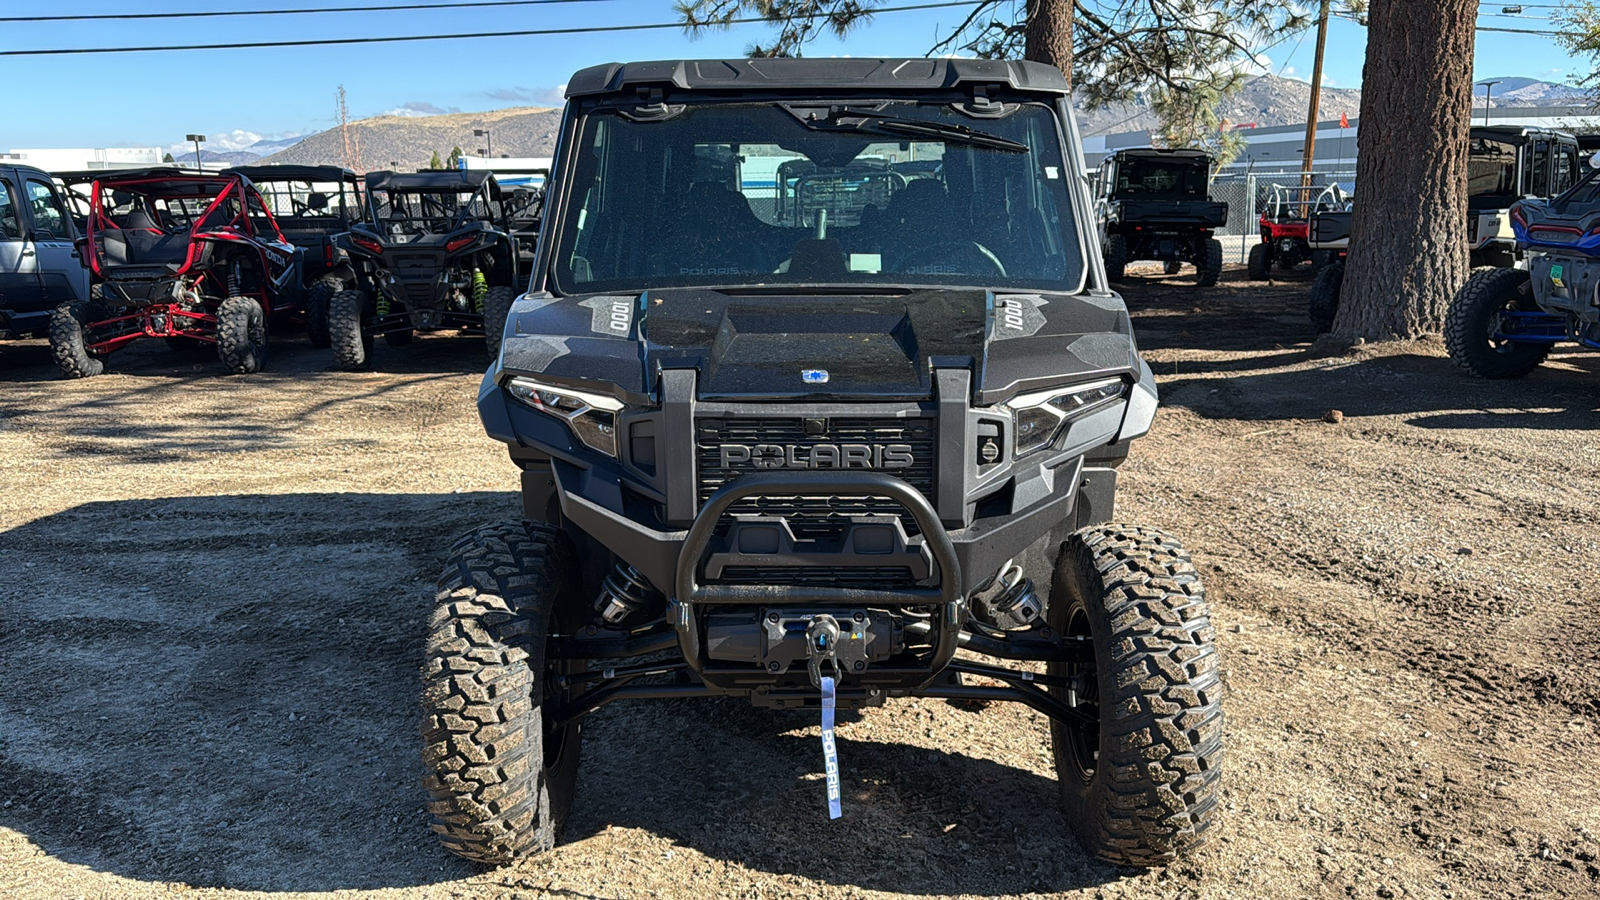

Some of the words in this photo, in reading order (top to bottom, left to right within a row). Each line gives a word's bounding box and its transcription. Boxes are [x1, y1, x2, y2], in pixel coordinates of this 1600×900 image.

[680, 267, 739, 275] POLARIS
[906, 264, 957, 275] OLARIS
[610, 301, 629, 331] 1000
[1005, 299, 1023, 331] 1000
[719, 444, 914, 468] POLARIS
[822, 729, 839, 801] POLARIS
